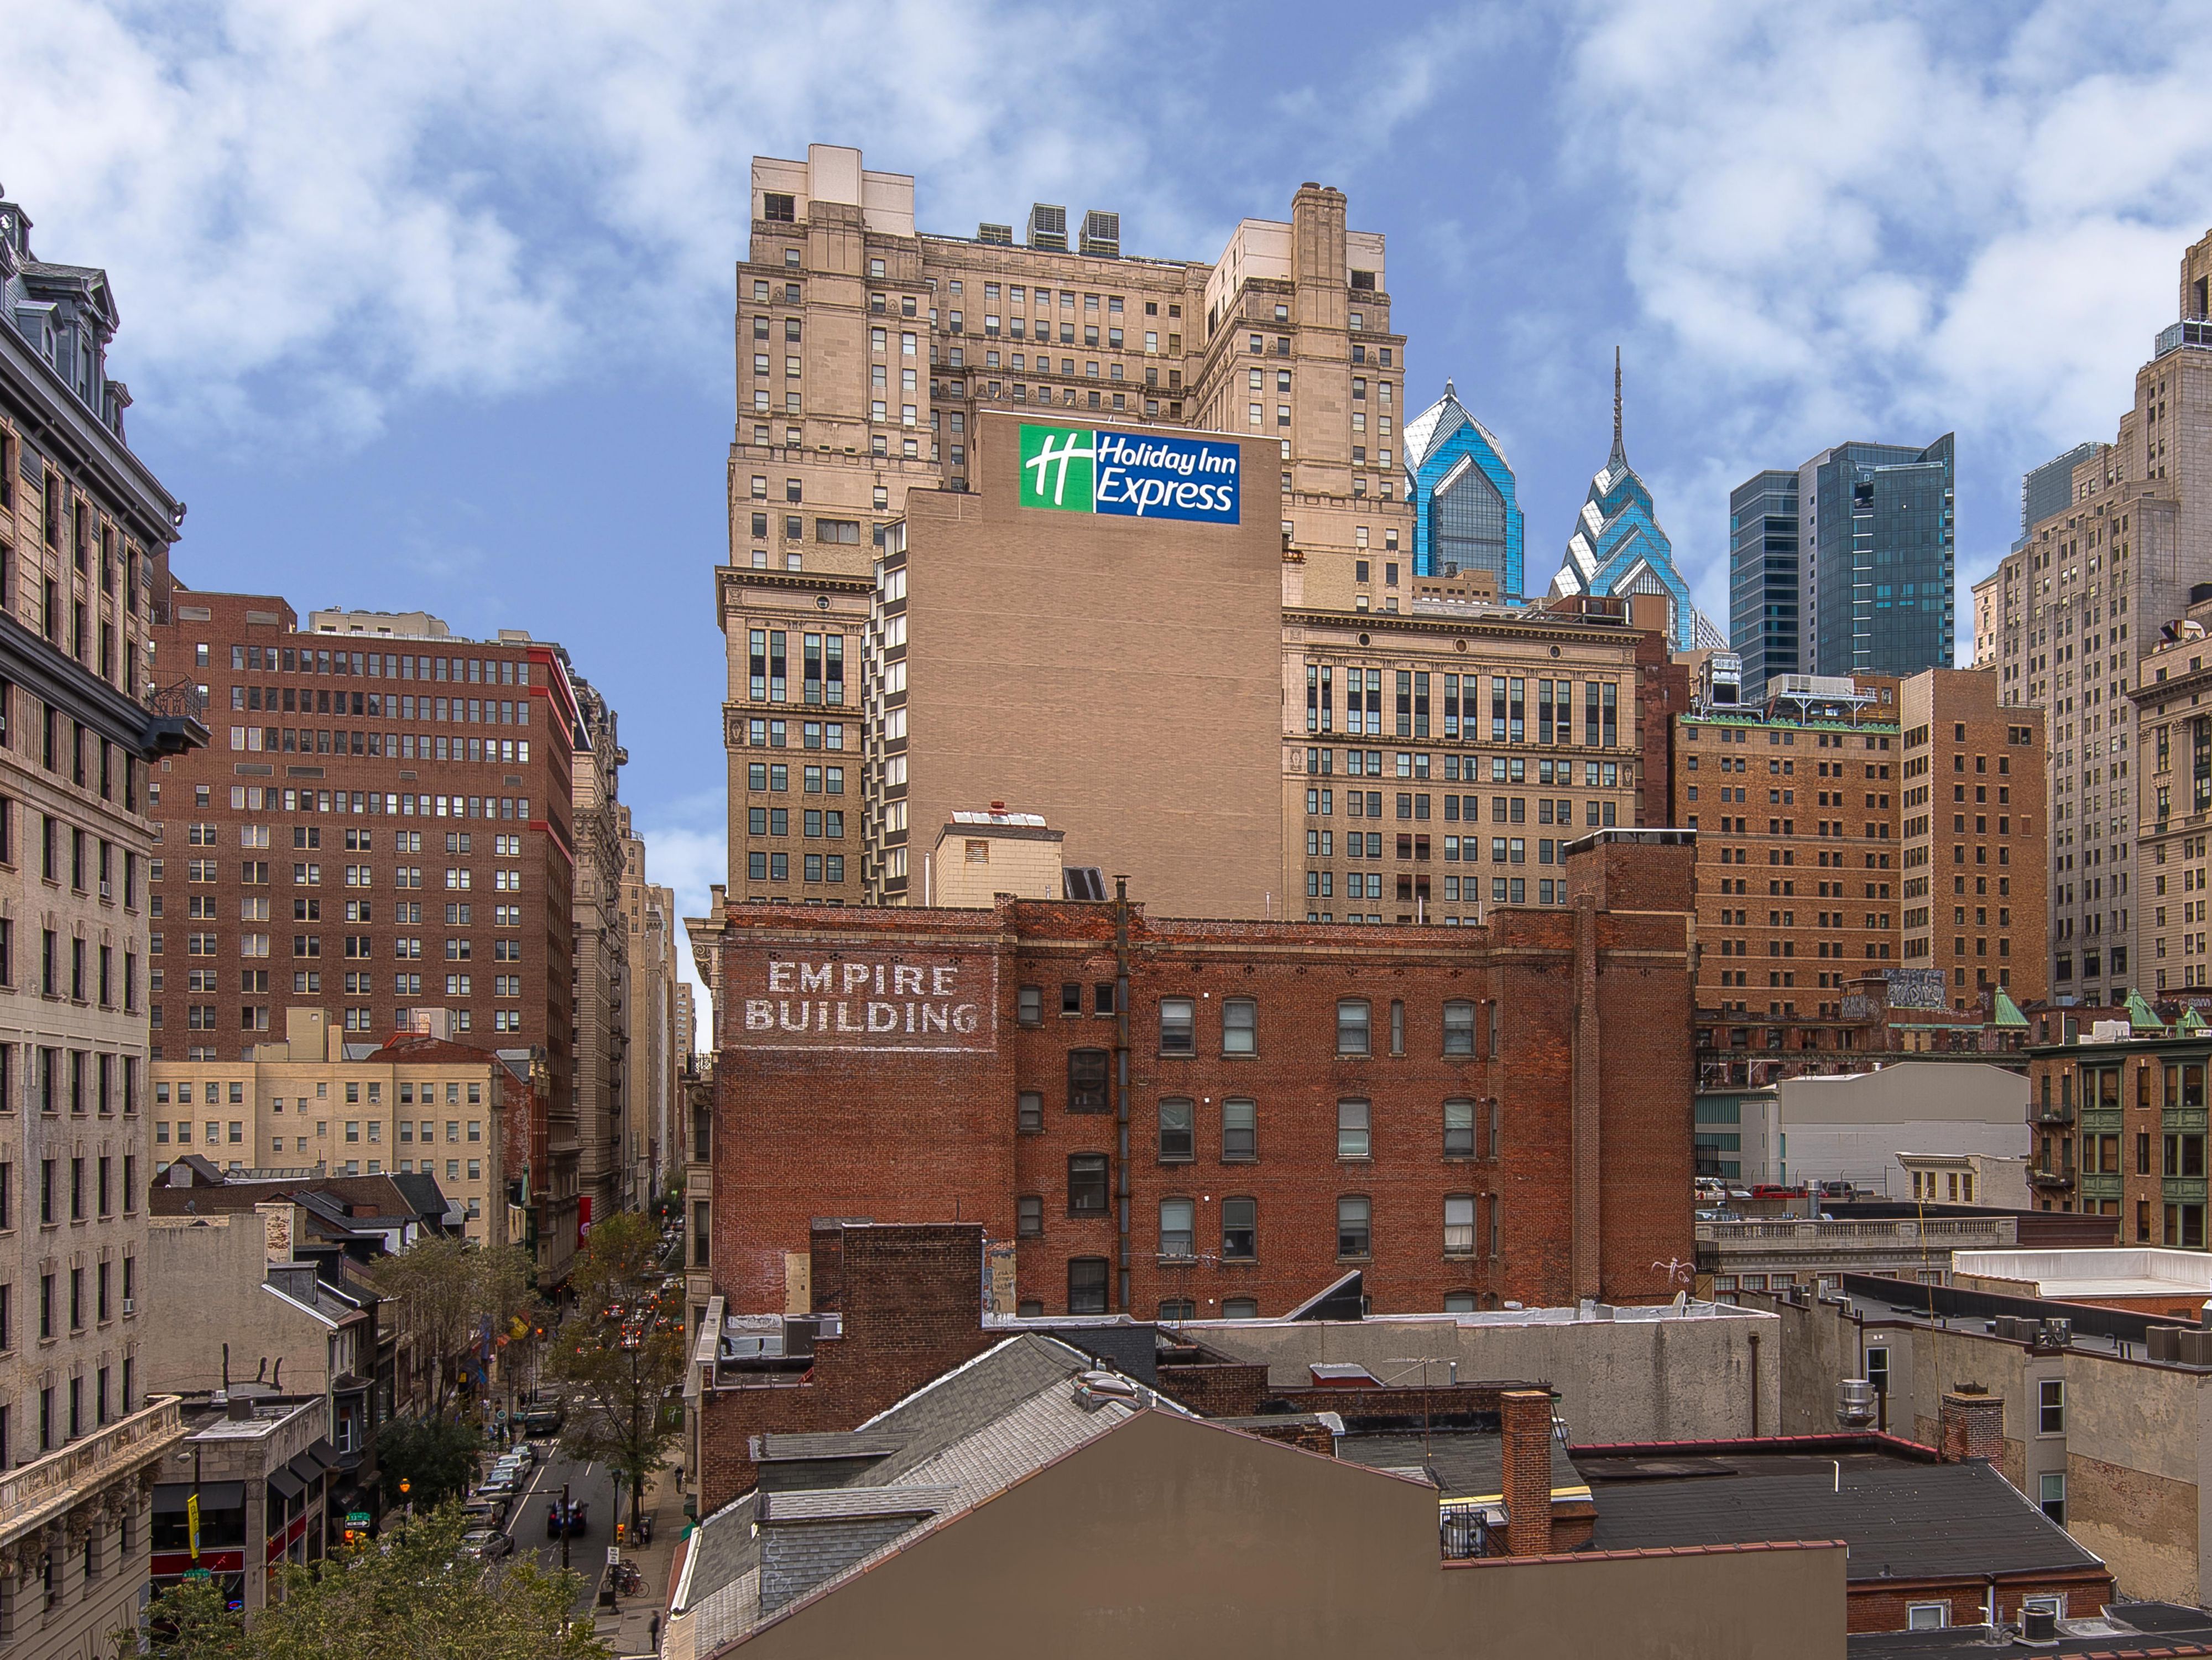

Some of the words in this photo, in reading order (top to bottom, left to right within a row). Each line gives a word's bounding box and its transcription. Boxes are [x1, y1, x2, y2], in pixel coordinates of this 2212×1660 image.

[1098, 436, 1196, 476] Holiday
[1199, 447, 1237, 474] Inn
[1097, 467, 1234, 516] Express
[769, 961, 958, 996] EMPIRE
[745, 1000, 978, 1033] BUILDING
